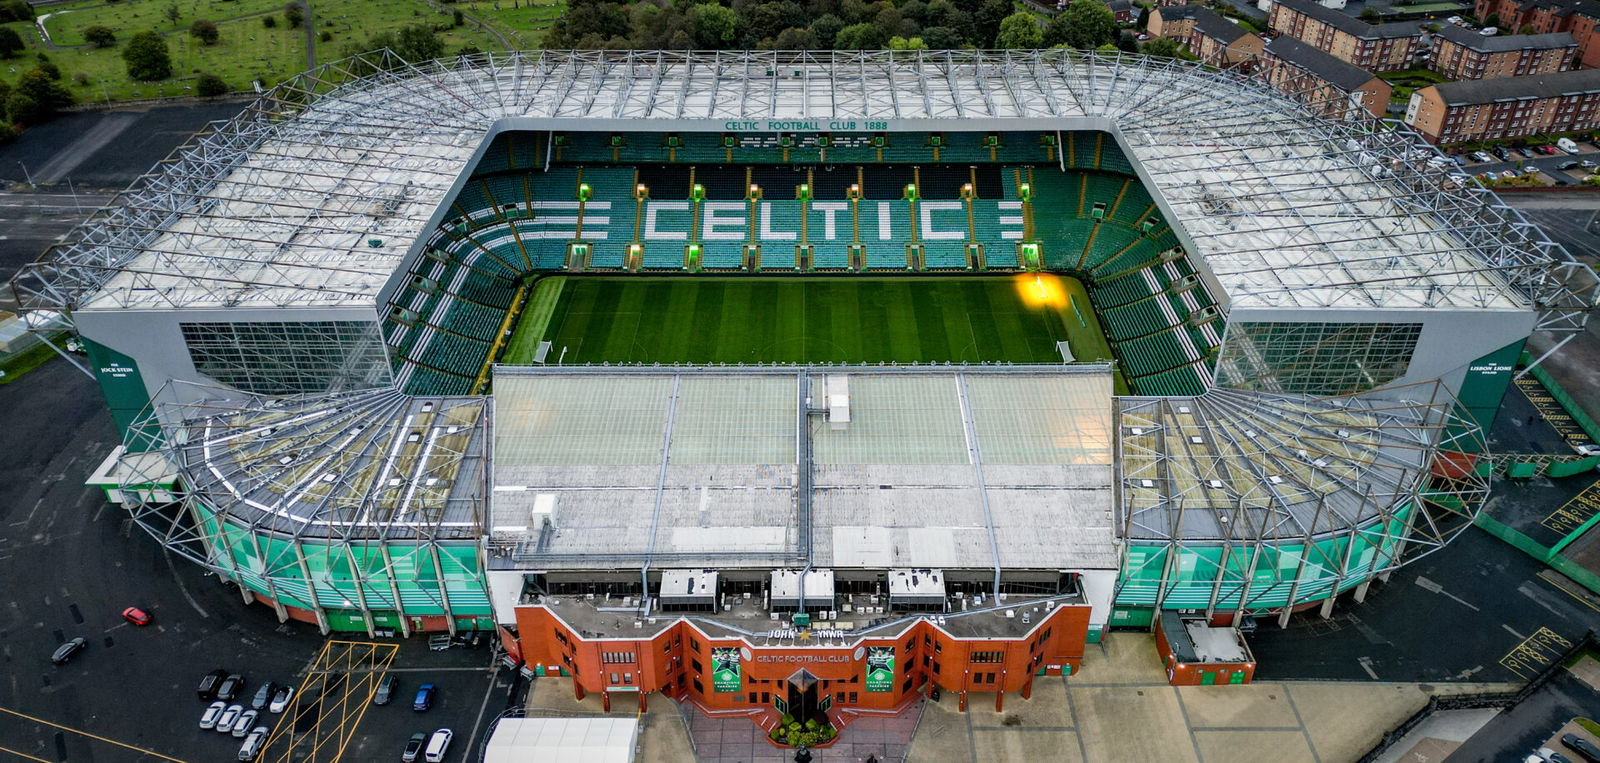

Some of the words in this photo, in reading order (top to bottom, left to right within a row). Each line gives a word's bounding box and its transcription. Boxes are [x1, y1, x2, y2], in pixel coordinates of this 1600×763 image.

[725, 121, 759, 130] CELTIC
[768, 121, 820, 130] FOOTBALL
[829, 121, 857, 130] CLUB
[864, 121, 888, 130] 1888
[644, 202, 965, 240] CELTIC
[768, 630, 795, 638] JOHN
